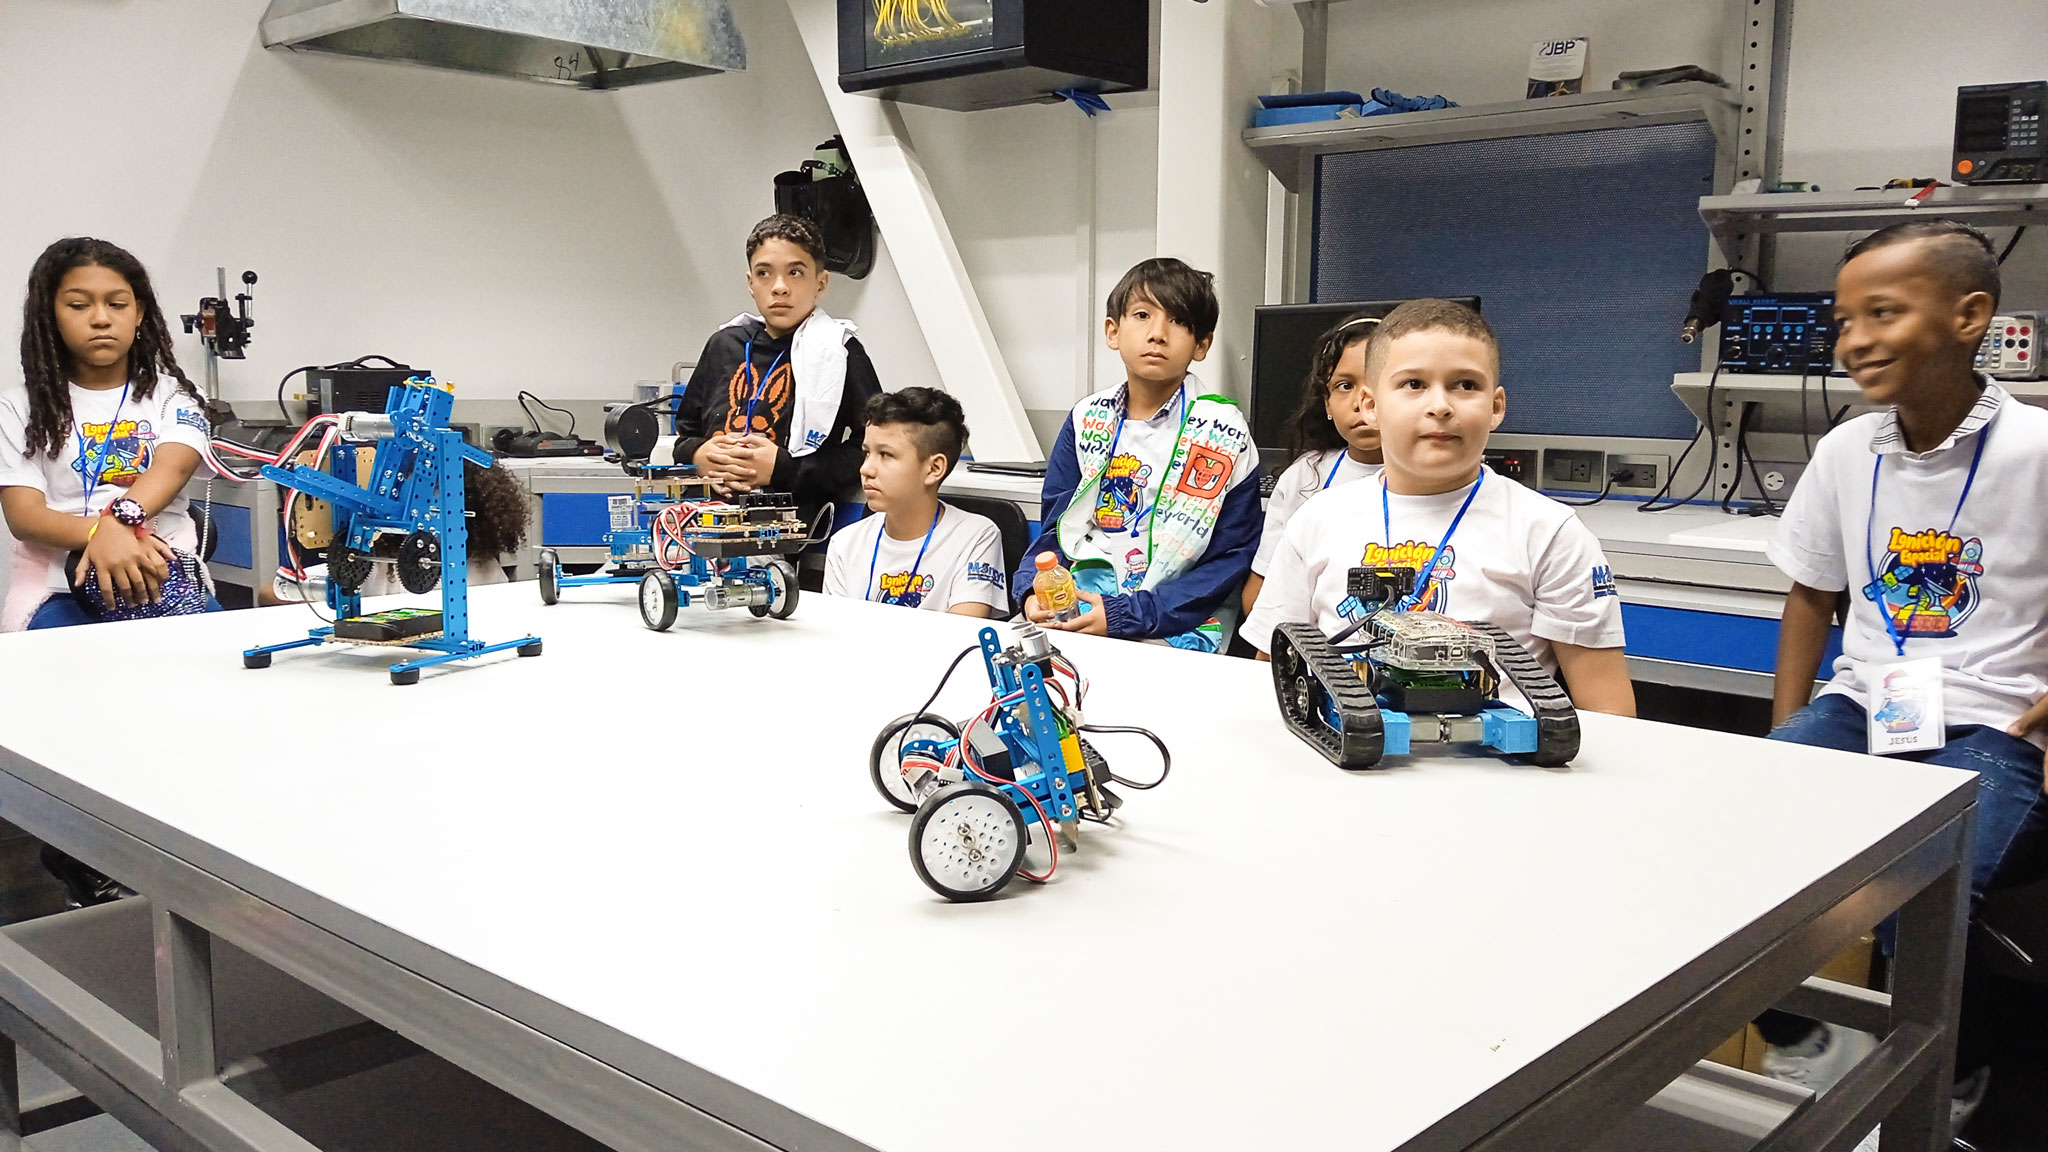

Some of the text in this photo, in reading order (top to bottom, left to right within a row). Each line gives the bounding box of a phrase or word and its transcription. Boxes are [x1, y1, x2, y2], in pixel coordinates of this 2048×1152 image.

[1545, 40, 1576, 56] JBP
[1888, 527, 1963, 554] Ignición
[1361, 540, 1438, 566] Ignición
[1900, 548, 1948, 567] Espacial
